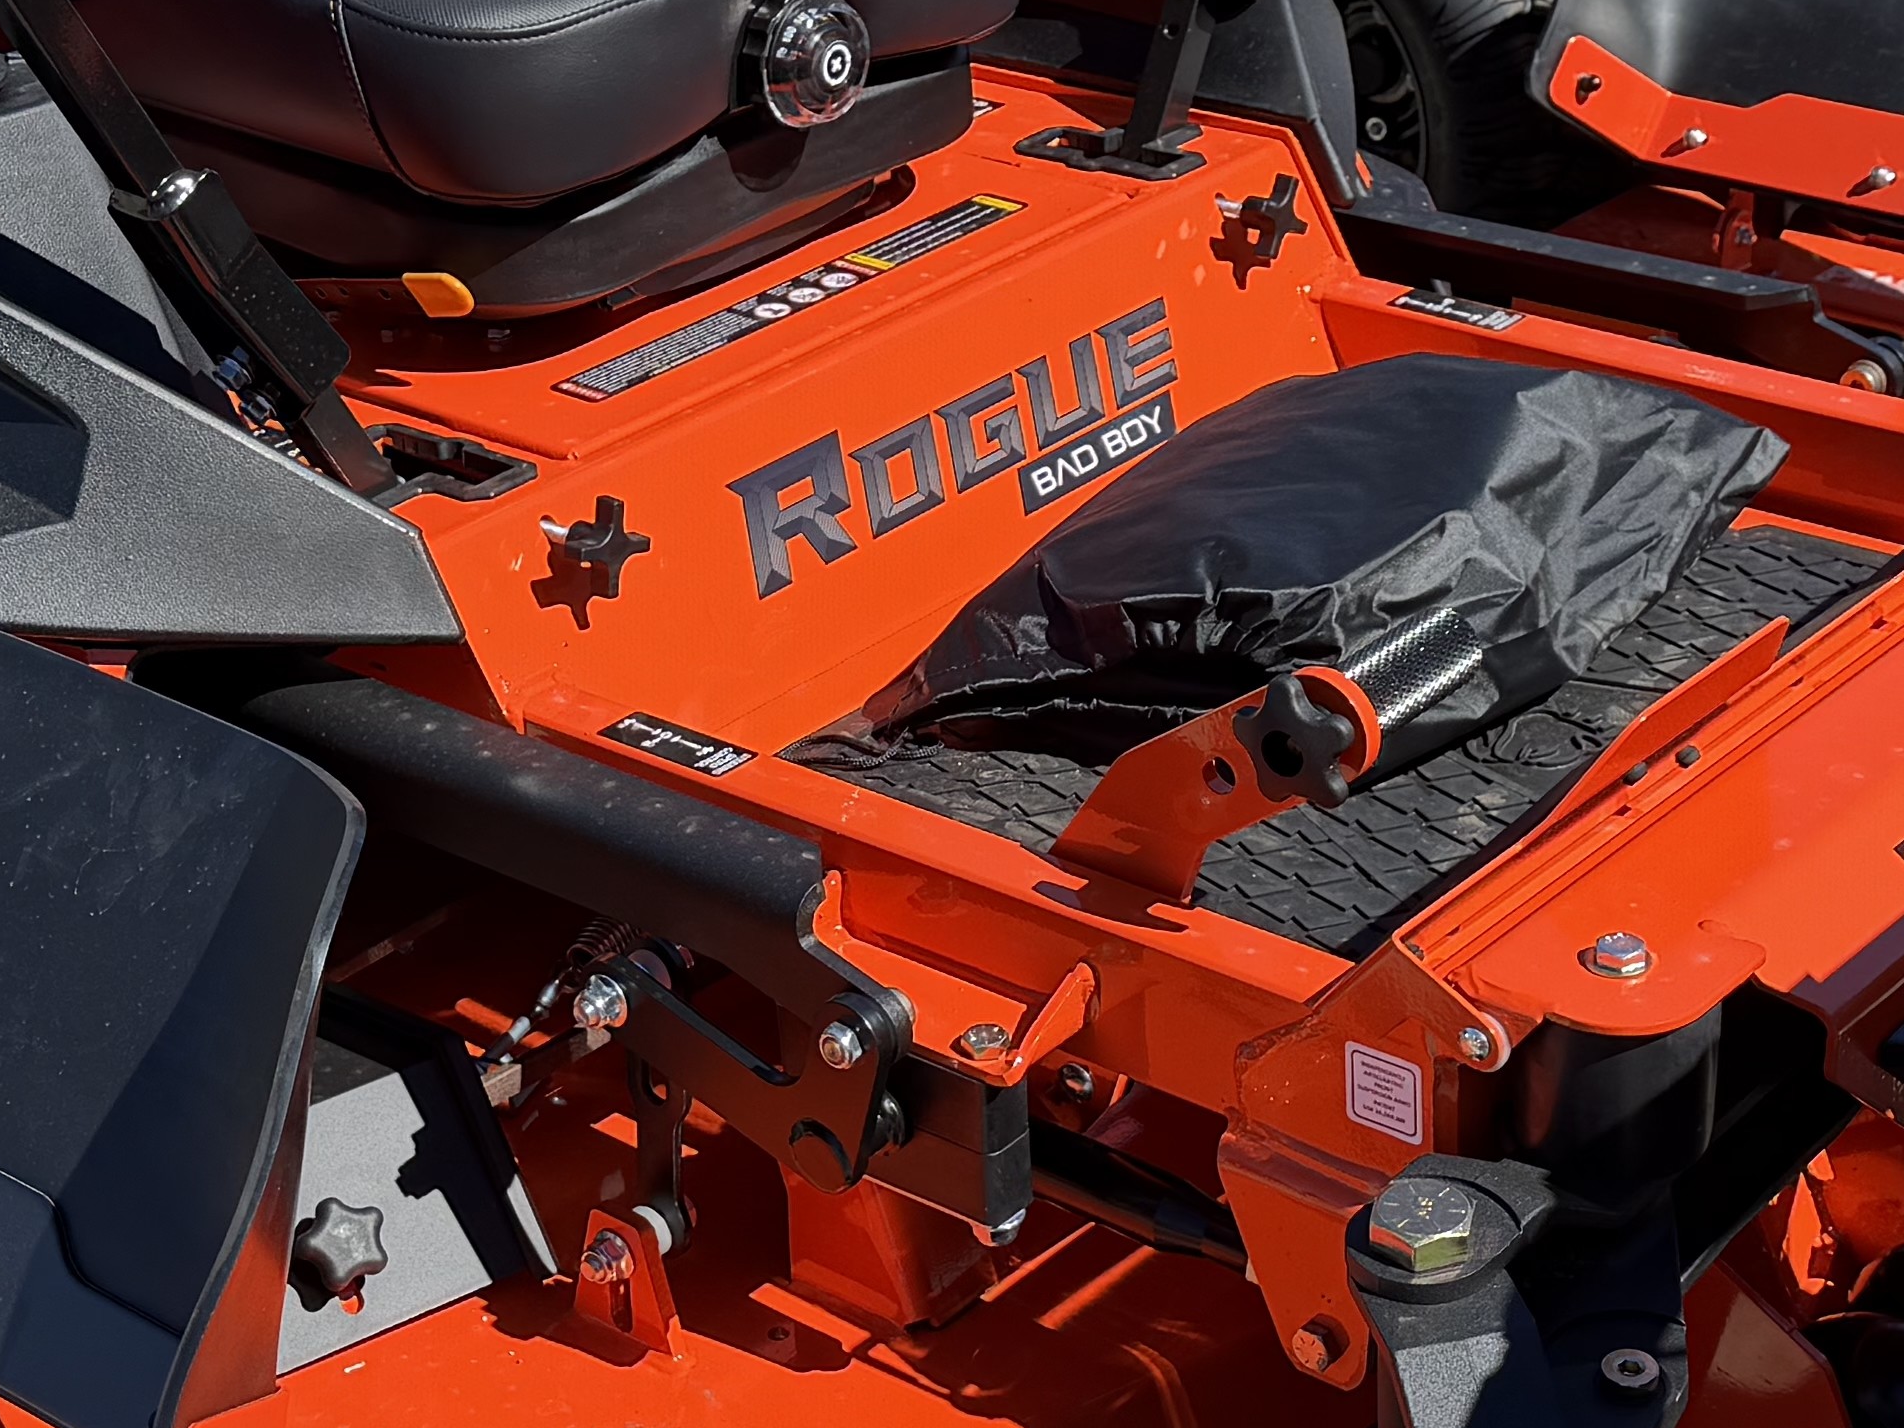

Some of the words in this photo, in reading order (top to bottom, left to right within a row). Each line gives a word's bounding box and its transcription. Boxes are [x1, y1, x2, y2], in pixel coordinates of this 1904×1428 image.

[725, 297, 1179, 600] ROGUE
[1030, 443, 1098, 496] BAD
[1100, 403, 1167, 461] BOY
